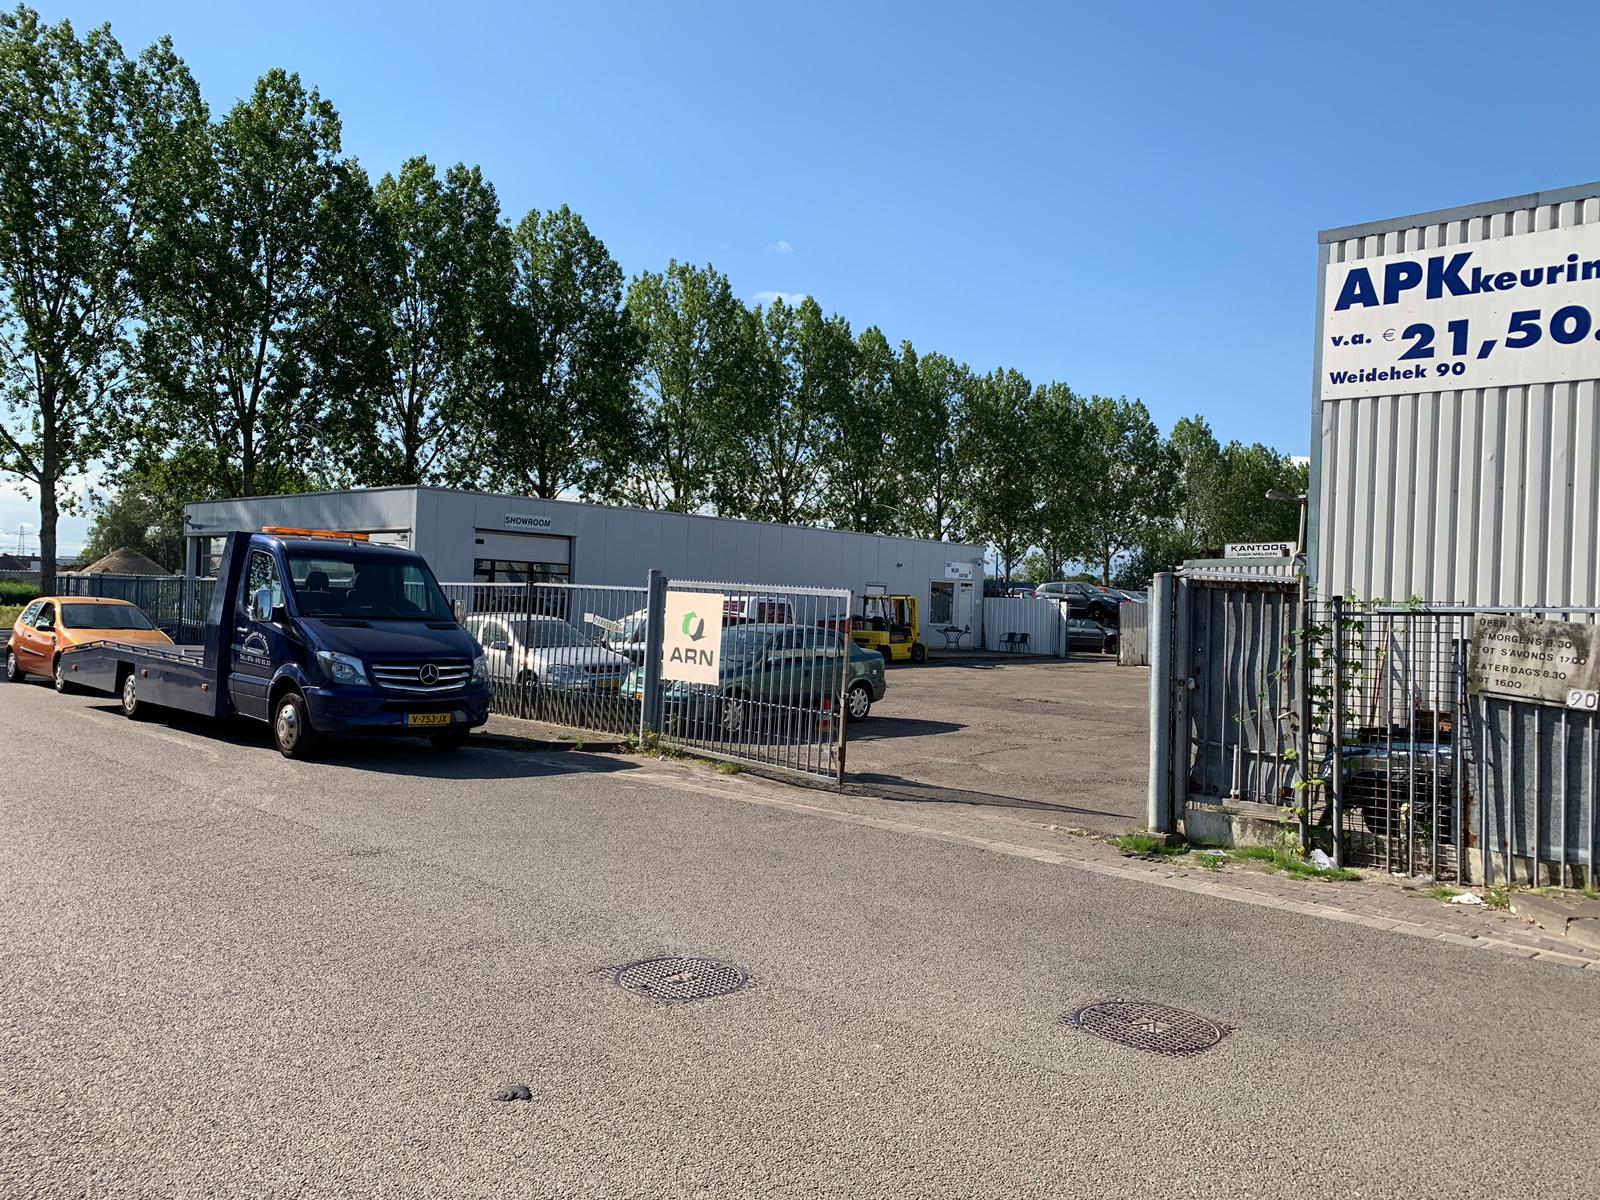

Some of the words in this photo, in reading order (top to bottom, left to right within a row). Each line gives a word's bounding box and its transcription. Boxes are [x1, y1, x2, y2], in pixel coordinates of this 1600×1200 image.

[1331, 333, 1372, 347] v.a.
[1329, 364, 1427, 385] Weidehek
[1436, 361, 1466, 378] 90
[505, 516, 551, 527] SHOWROOM
[1230, 544, 1287, 552] KANTOOR
[1480, 618, 1507, 628] OPEN
[1478, 631, 1542, 646] S'MORGENS
[669, 646, 714, 667] ARN
[1476, 646, 1495, 655] OT
[1501, 648, 1554, 661] S'AVONDS
[1473, 676, 1490, 685] OT
[1542, 670, 1567, 680] 8.30
